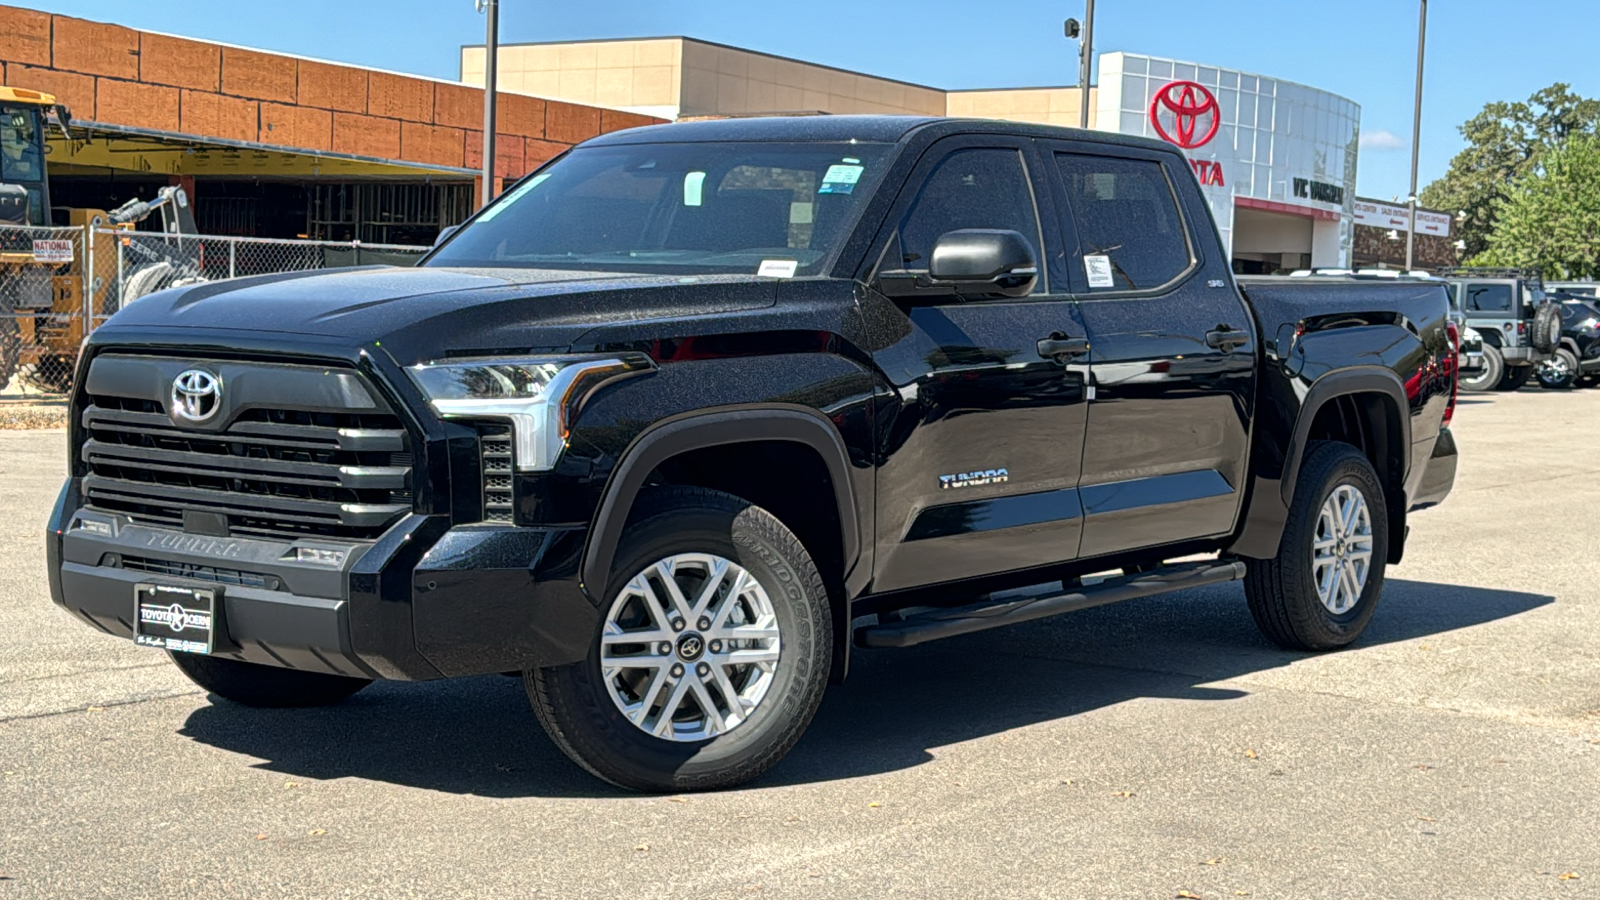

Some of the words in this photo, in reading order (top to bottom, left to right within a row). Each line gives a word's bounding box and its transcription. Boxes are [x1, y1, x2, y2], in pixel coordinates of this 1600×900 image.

[1293, 177, 1308, 198] VIC
[1362, 204, 1377, 213] CENTER
[1381, 207, 1392, 216] SALES
[34, 241, 71, 250] NATIONAL
[129, 239, 159, 262] EERE
[938, 467, 1009, 490] TUNDRA
[146, 531, 241, 558] TUNDRA
[141, 608, 173, 622] TOYOTA
[731, 530, 813, 714] BRIDGESTONE
